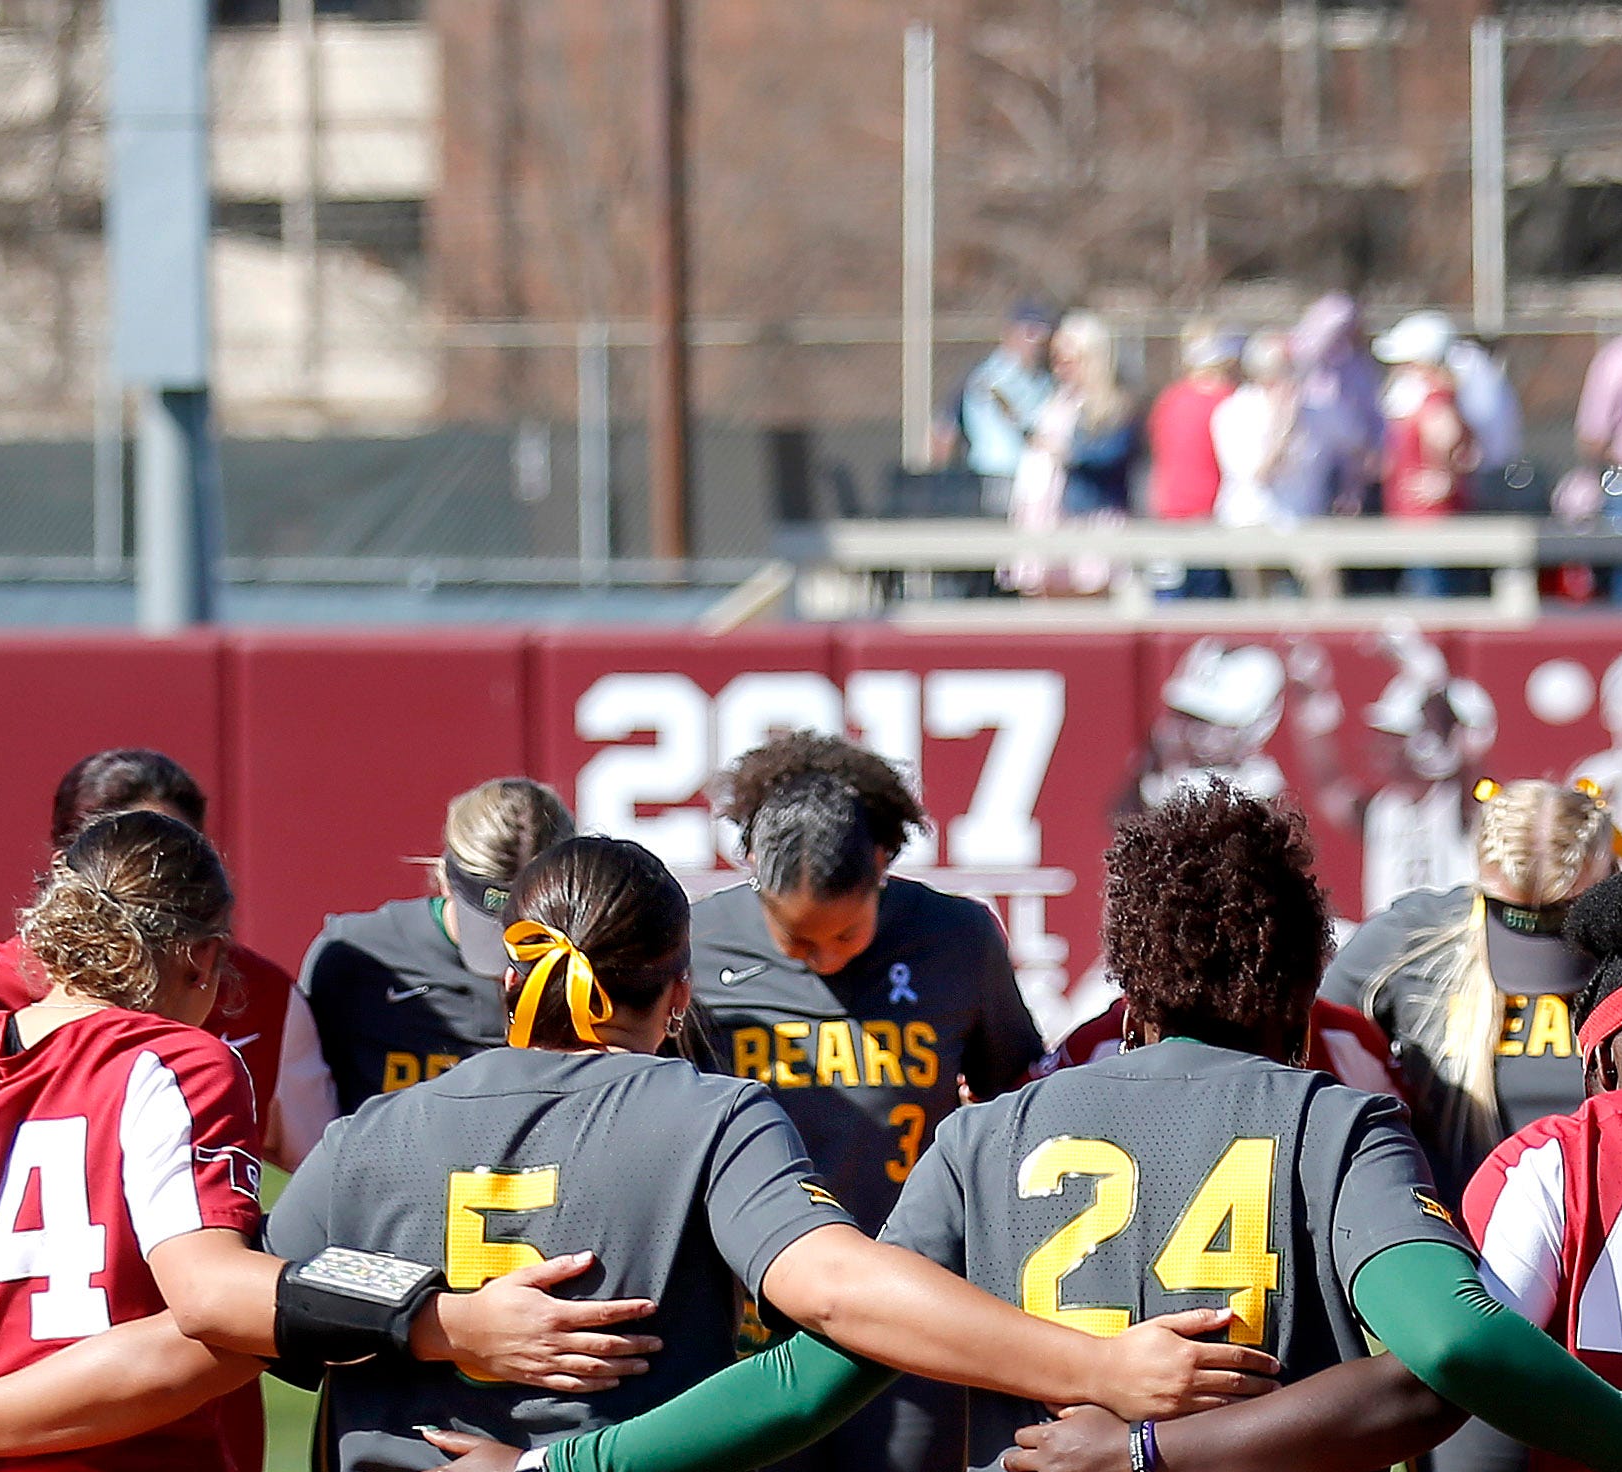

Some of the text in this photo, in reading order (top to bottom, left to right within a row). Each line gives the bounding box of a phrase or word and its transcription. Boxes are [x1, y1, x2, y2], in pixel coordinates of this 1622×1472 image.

[733, 1020, 940, 1089] BEARS
[445, 1163, 560, 1385] 5
[1019, 1135, 1281, 1346] 24
